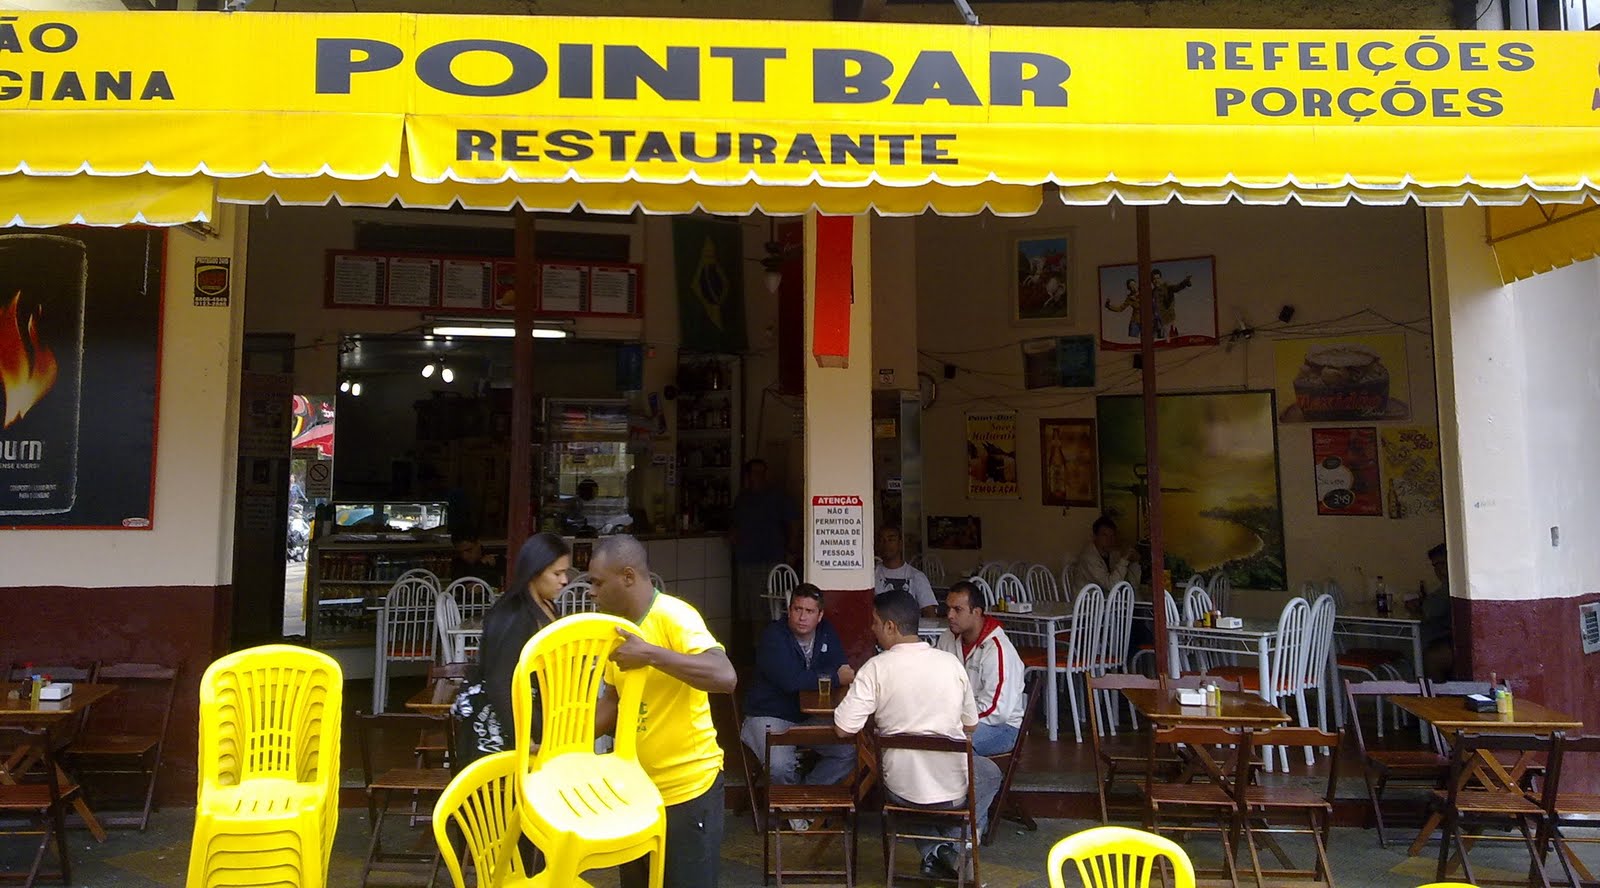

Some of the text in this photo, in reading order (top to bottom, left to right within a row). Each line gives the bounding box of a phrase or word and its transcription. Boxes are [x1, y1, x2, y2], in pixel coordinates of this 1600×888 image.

[314, 38, 1072, 108] POINT BAR
[1185, 35, 1536, 77] REFEIÇÕES
[0, 69, 175, 101] GIANA
[1214, 80, 1505, 122] PORÇÕES
[455, 128, 959, 166] RESTAURANTE
[0, 440, 42, 461] urn
[818, 496, 859, 505] ATENÇÃO
[827, 507, 843, 515] NÃO
